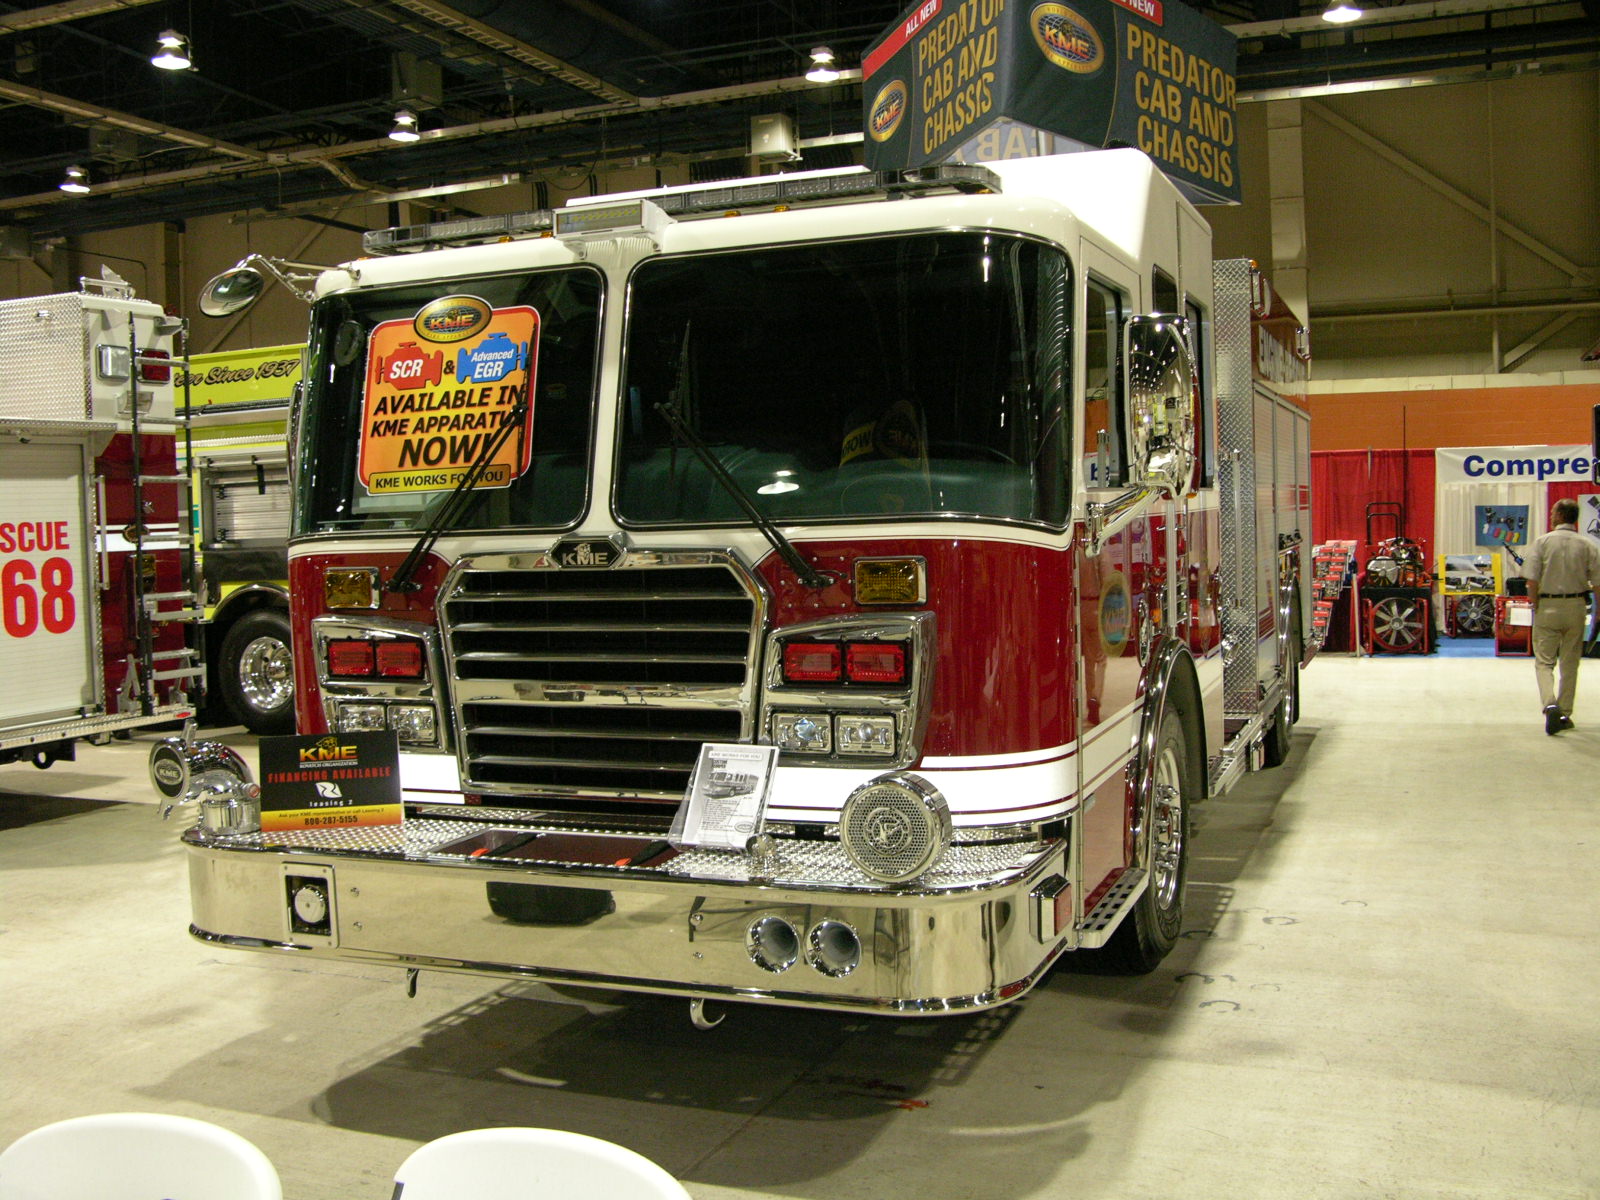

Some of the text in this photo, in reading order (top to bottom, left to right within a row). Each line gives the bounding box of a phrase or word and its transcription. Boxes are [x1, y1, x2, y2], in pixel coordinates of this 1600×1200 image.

[905, 0, 937, 38] ALL NEW
[1045, 24, 1089, 59] KME
[923, 26, 999, 114] CAB AND
[1126, 22, 1237, 111] PREDATOR
[924, 72, 995, 155] CHASSIS
[1134, 71, 1233, 147] CAB AND
[1137, 115, 1233, 187] CHASSIS
[430, 313, 474, 331] KME
[205, 366, 255, 386] Since
[255, 359, 301, 381] 1937
[390, 348, 515, 380] SCR & Advanced
[474, 361, 504, 379] EGR
[373, 383, 527, 416] AVAILABLE IN
[370, 410, 523, 438] KME APPARATU
[375, 477, 400, 489] KME
[403, 473, 447, 487] WORKS
[1463, 455, 1597, 481] Compre
[562, 552, 608, 565] KME
[1, 556, 76, 638] 68
[300, 745, 358, 762] KME
[159, 768, 179, 778] KME
[267, 766, 391, 784] FINANCING AVAILABLE
